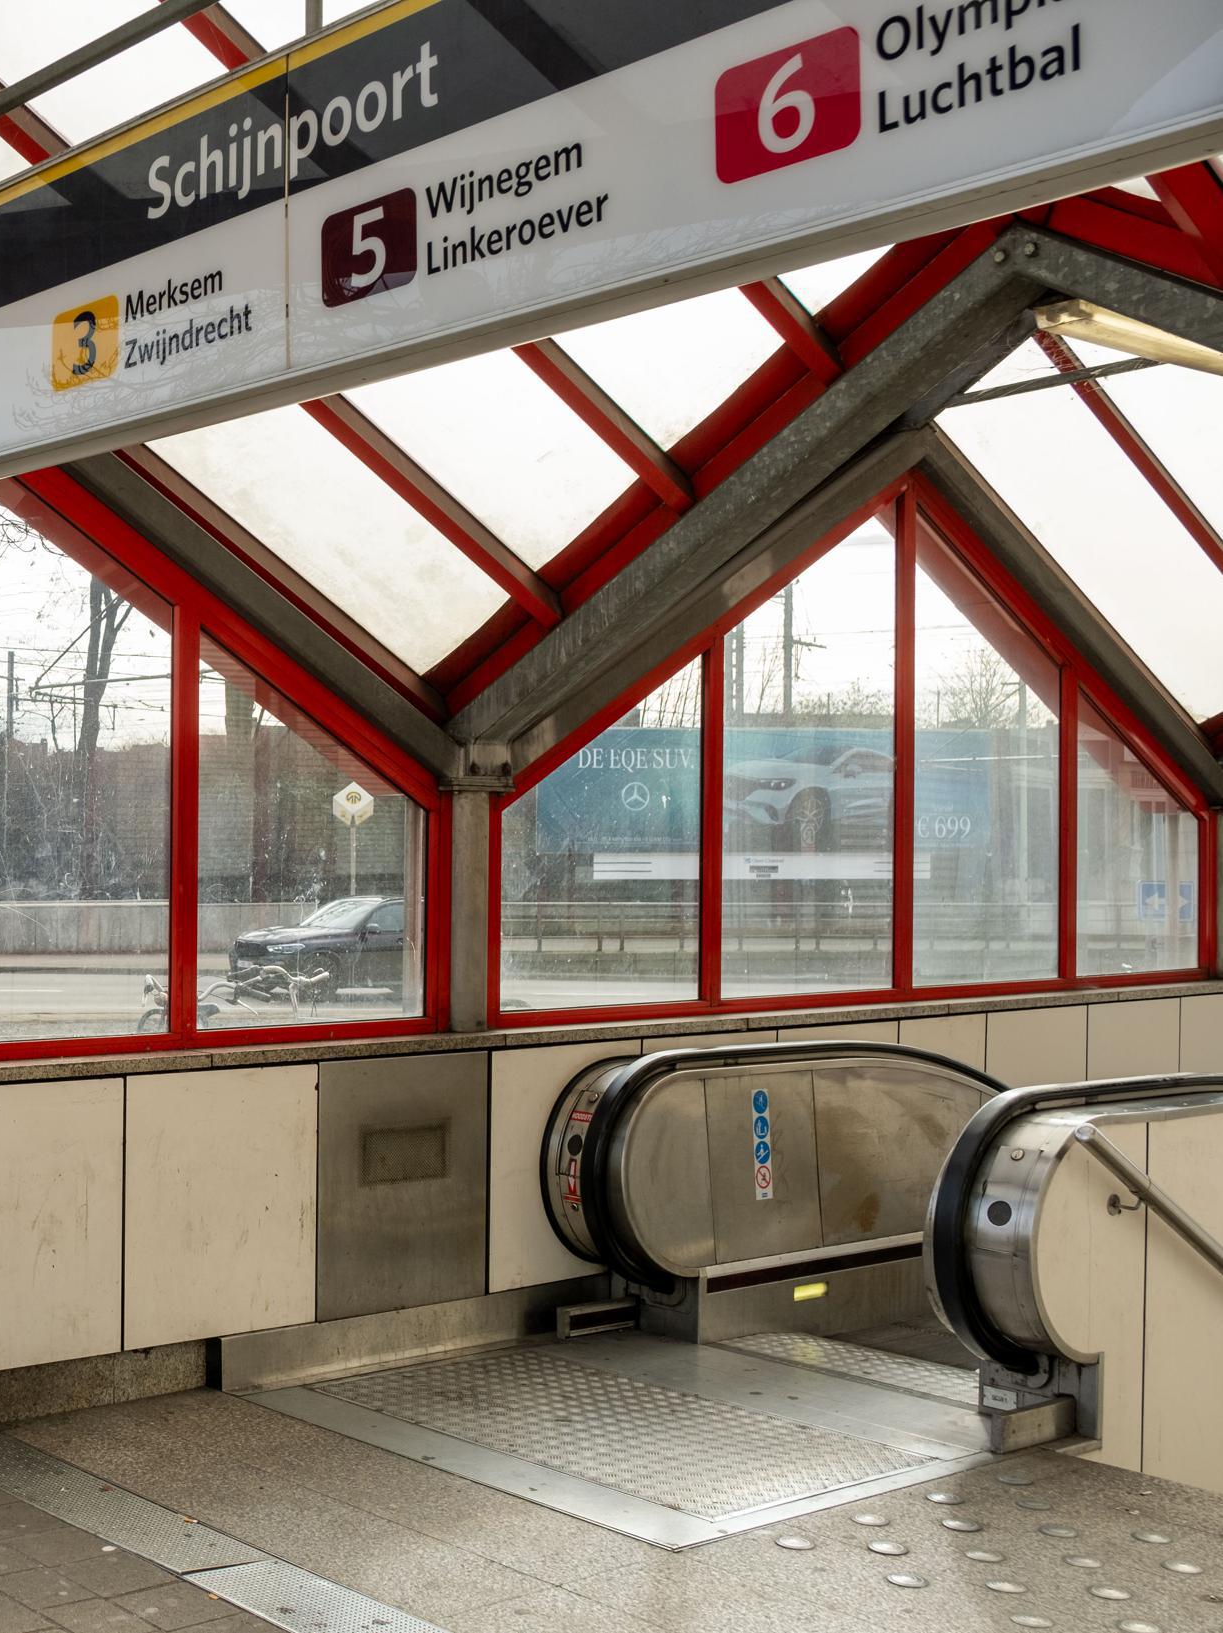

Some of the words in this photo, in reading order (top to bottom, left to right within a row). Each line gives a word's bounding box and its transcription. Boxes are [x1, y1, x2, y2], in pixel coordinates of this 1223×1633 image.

[876, 0, 1063, 61] Olymp
[757, 53, 815, 154] 6
[878, 23, 1081, 133] Luchtbal
[147, 43, 438, 219] Schijnpoort
[425, 142, 583, 218] Wijnegem
[351, 206, 386, 288] 5
[427, 193, 608, 276] Linkeroever
[125, 269, 223, 323] Merksem
[72, 310, 97, 375] 3
[124, 304, 252, 369] Zwijndrecht
[577, 748, 604, 769] DE
[609, 748, 648, 773] EQE
[652, 748, 695, 769] SUV.
[935, 815, 971, 839] 699
